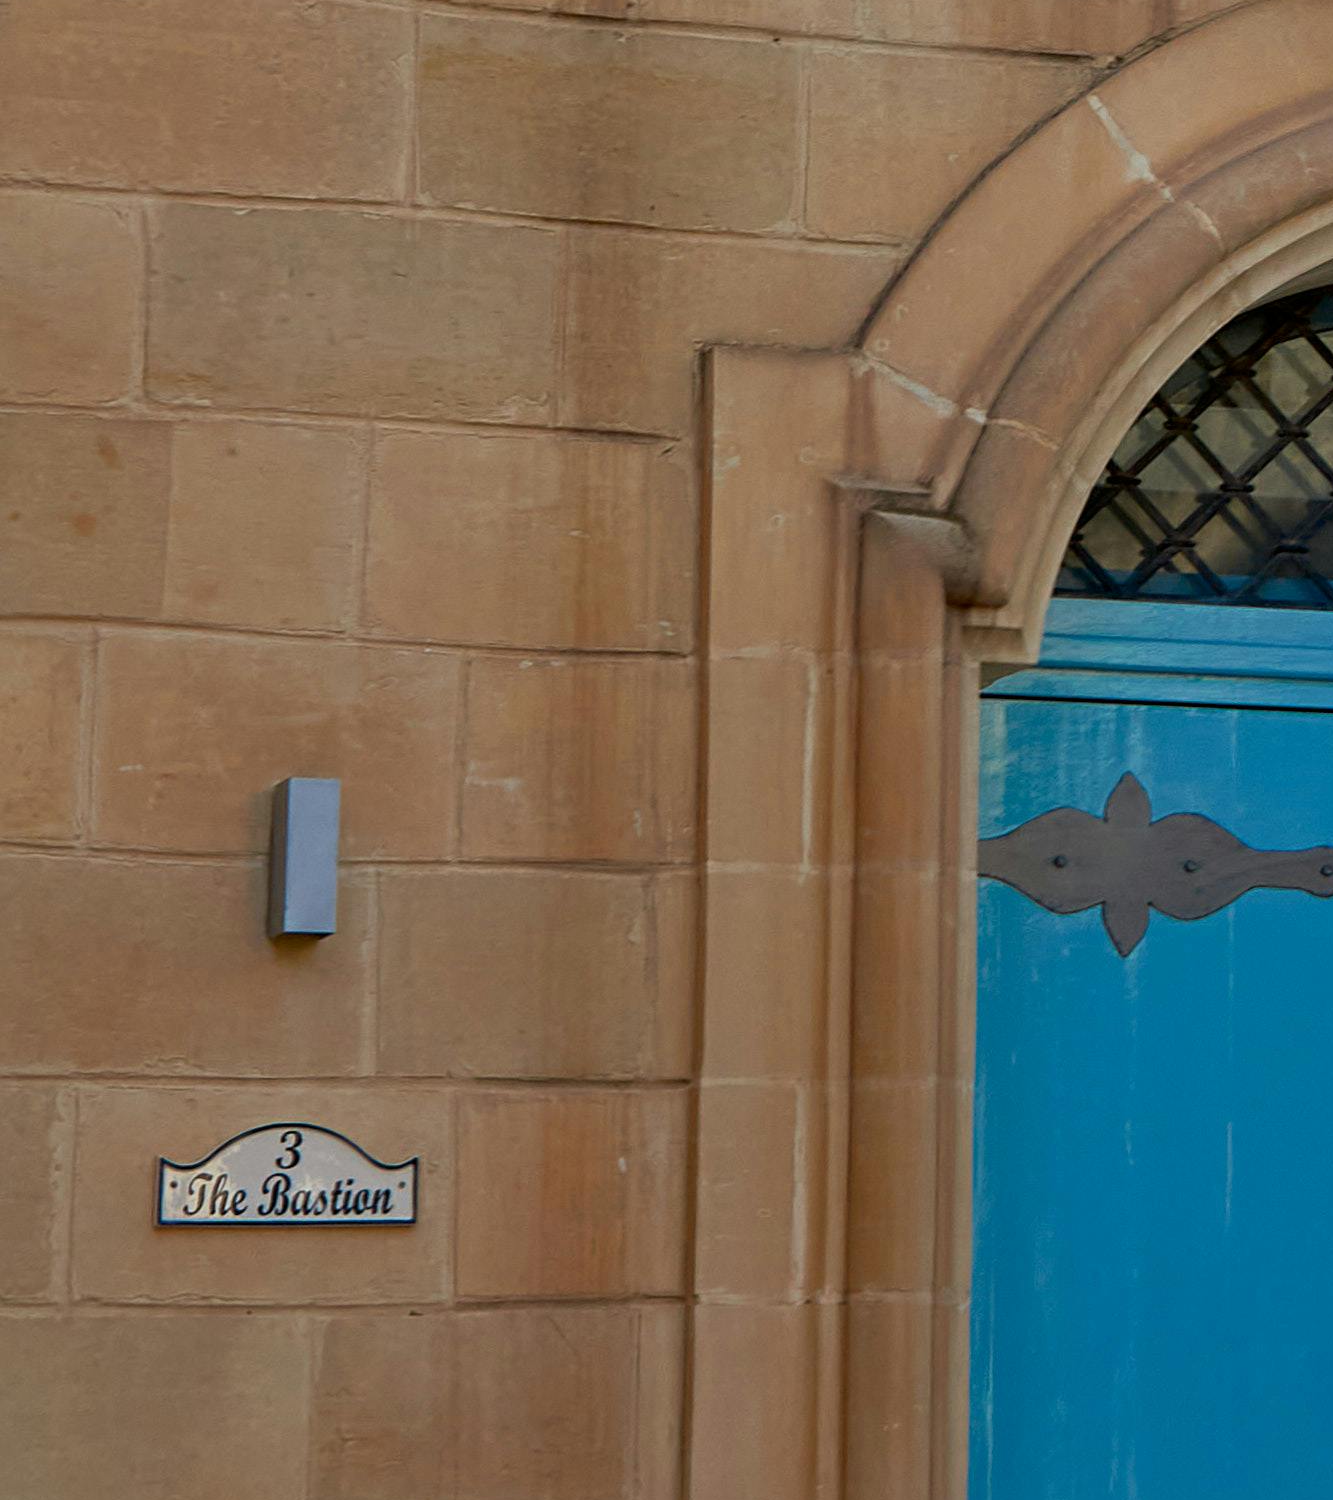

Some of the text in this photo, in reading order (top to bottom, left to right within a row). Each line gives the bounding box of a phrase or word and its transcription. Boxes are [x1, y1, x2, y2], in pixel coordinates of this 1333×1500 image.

[276, 1130, 303, 1169] 3
[183, 1172, 393, 1216] The Bastion
